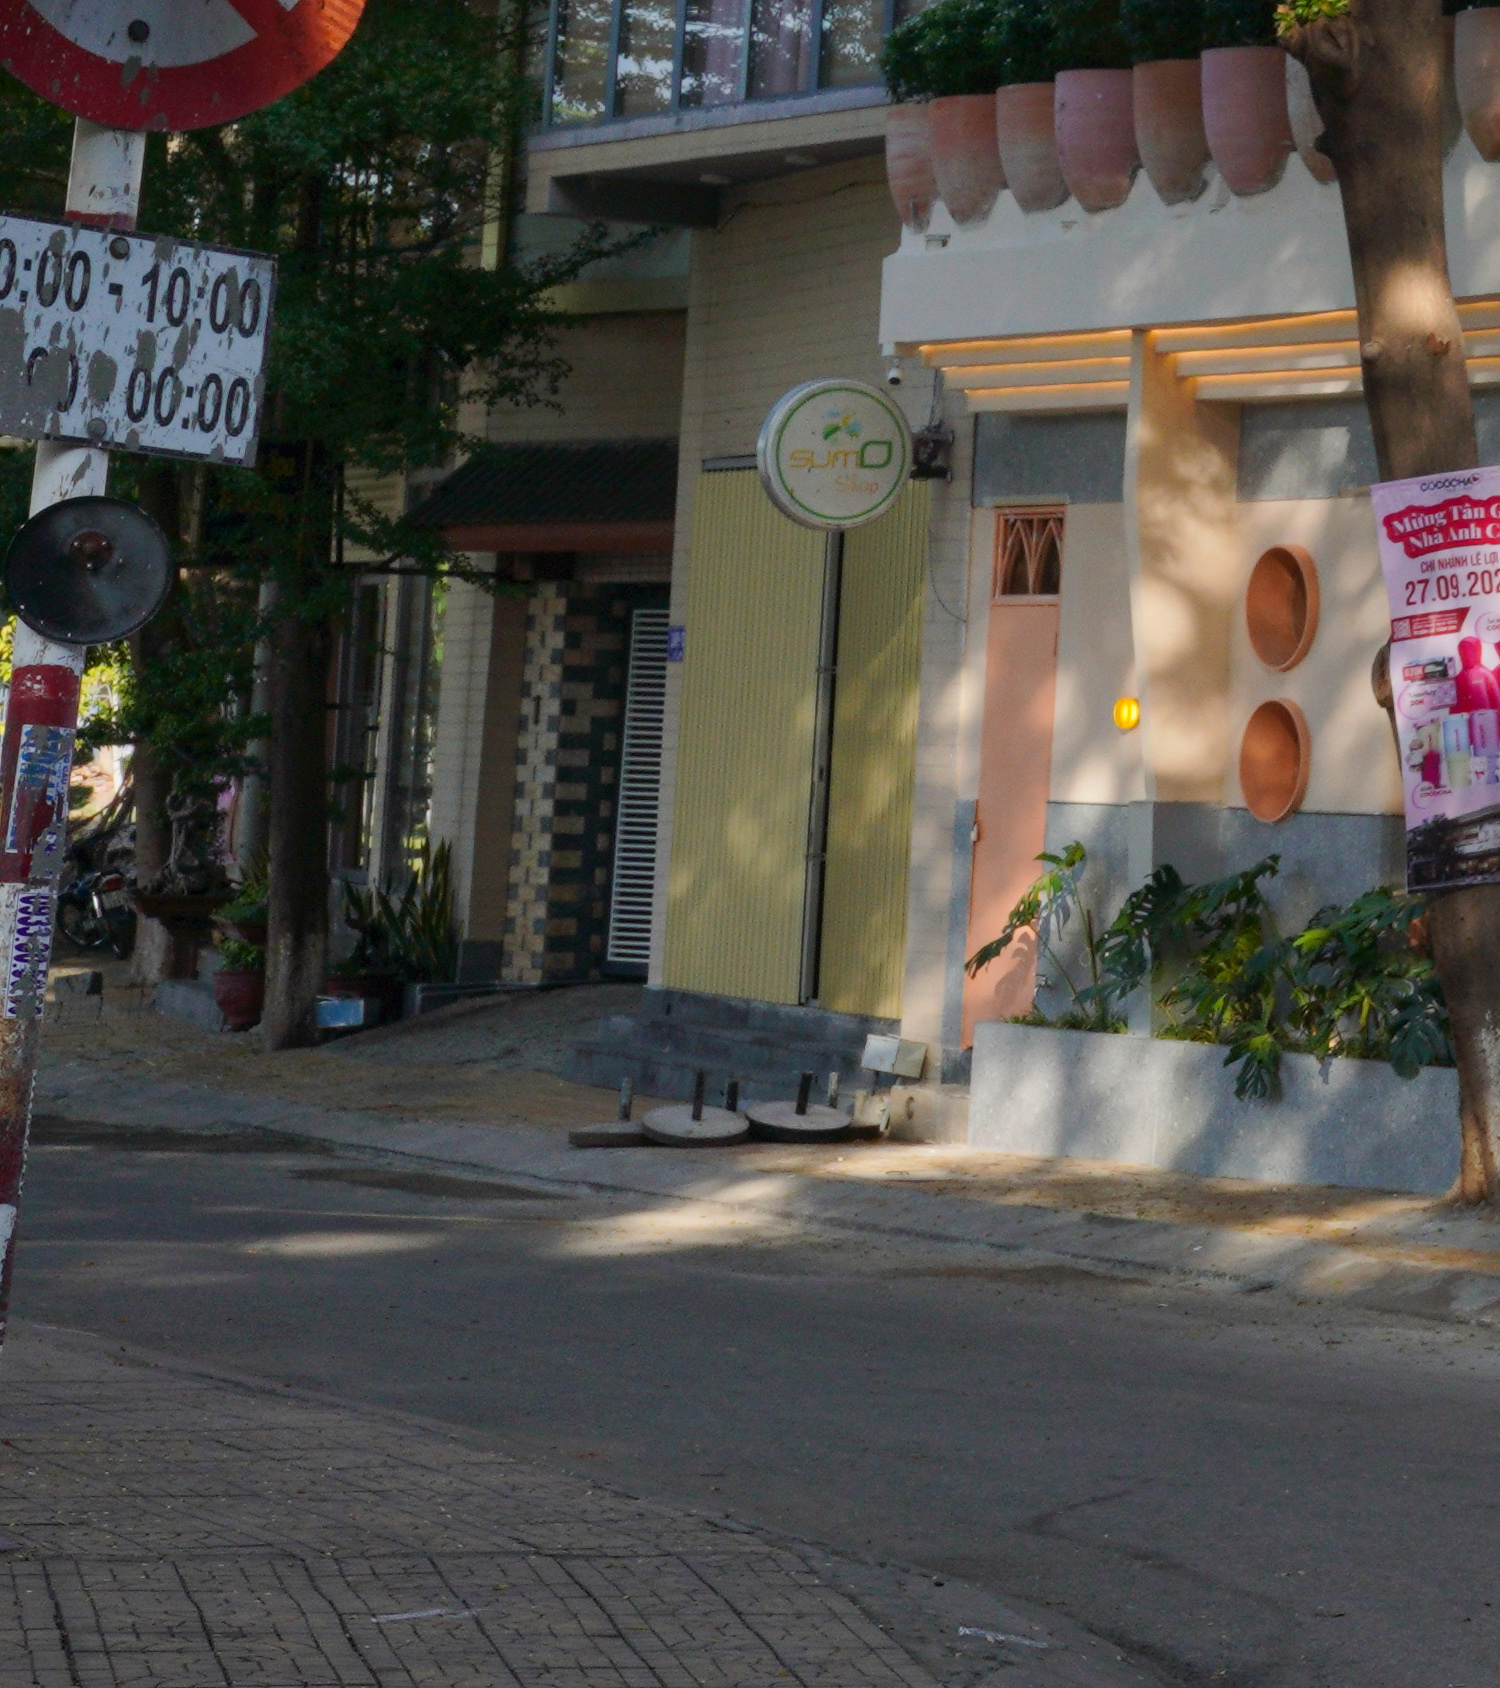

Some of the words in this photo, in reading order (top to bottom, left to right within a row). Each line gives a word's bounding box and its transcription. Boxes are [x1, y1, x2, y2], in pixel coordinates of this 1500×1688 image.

[142, 262, 260, 338] 10:00
[126, 366, 249, 427] 00:00
[1392, 510, 1447, 536] Mừng
[1449, 503, 1485, 521] Tân
[1409, 527, 1444, 551] Nhà
[1447, 523, 1482, 542] Anh
[1471, 551, 1481, 566] LÊ
